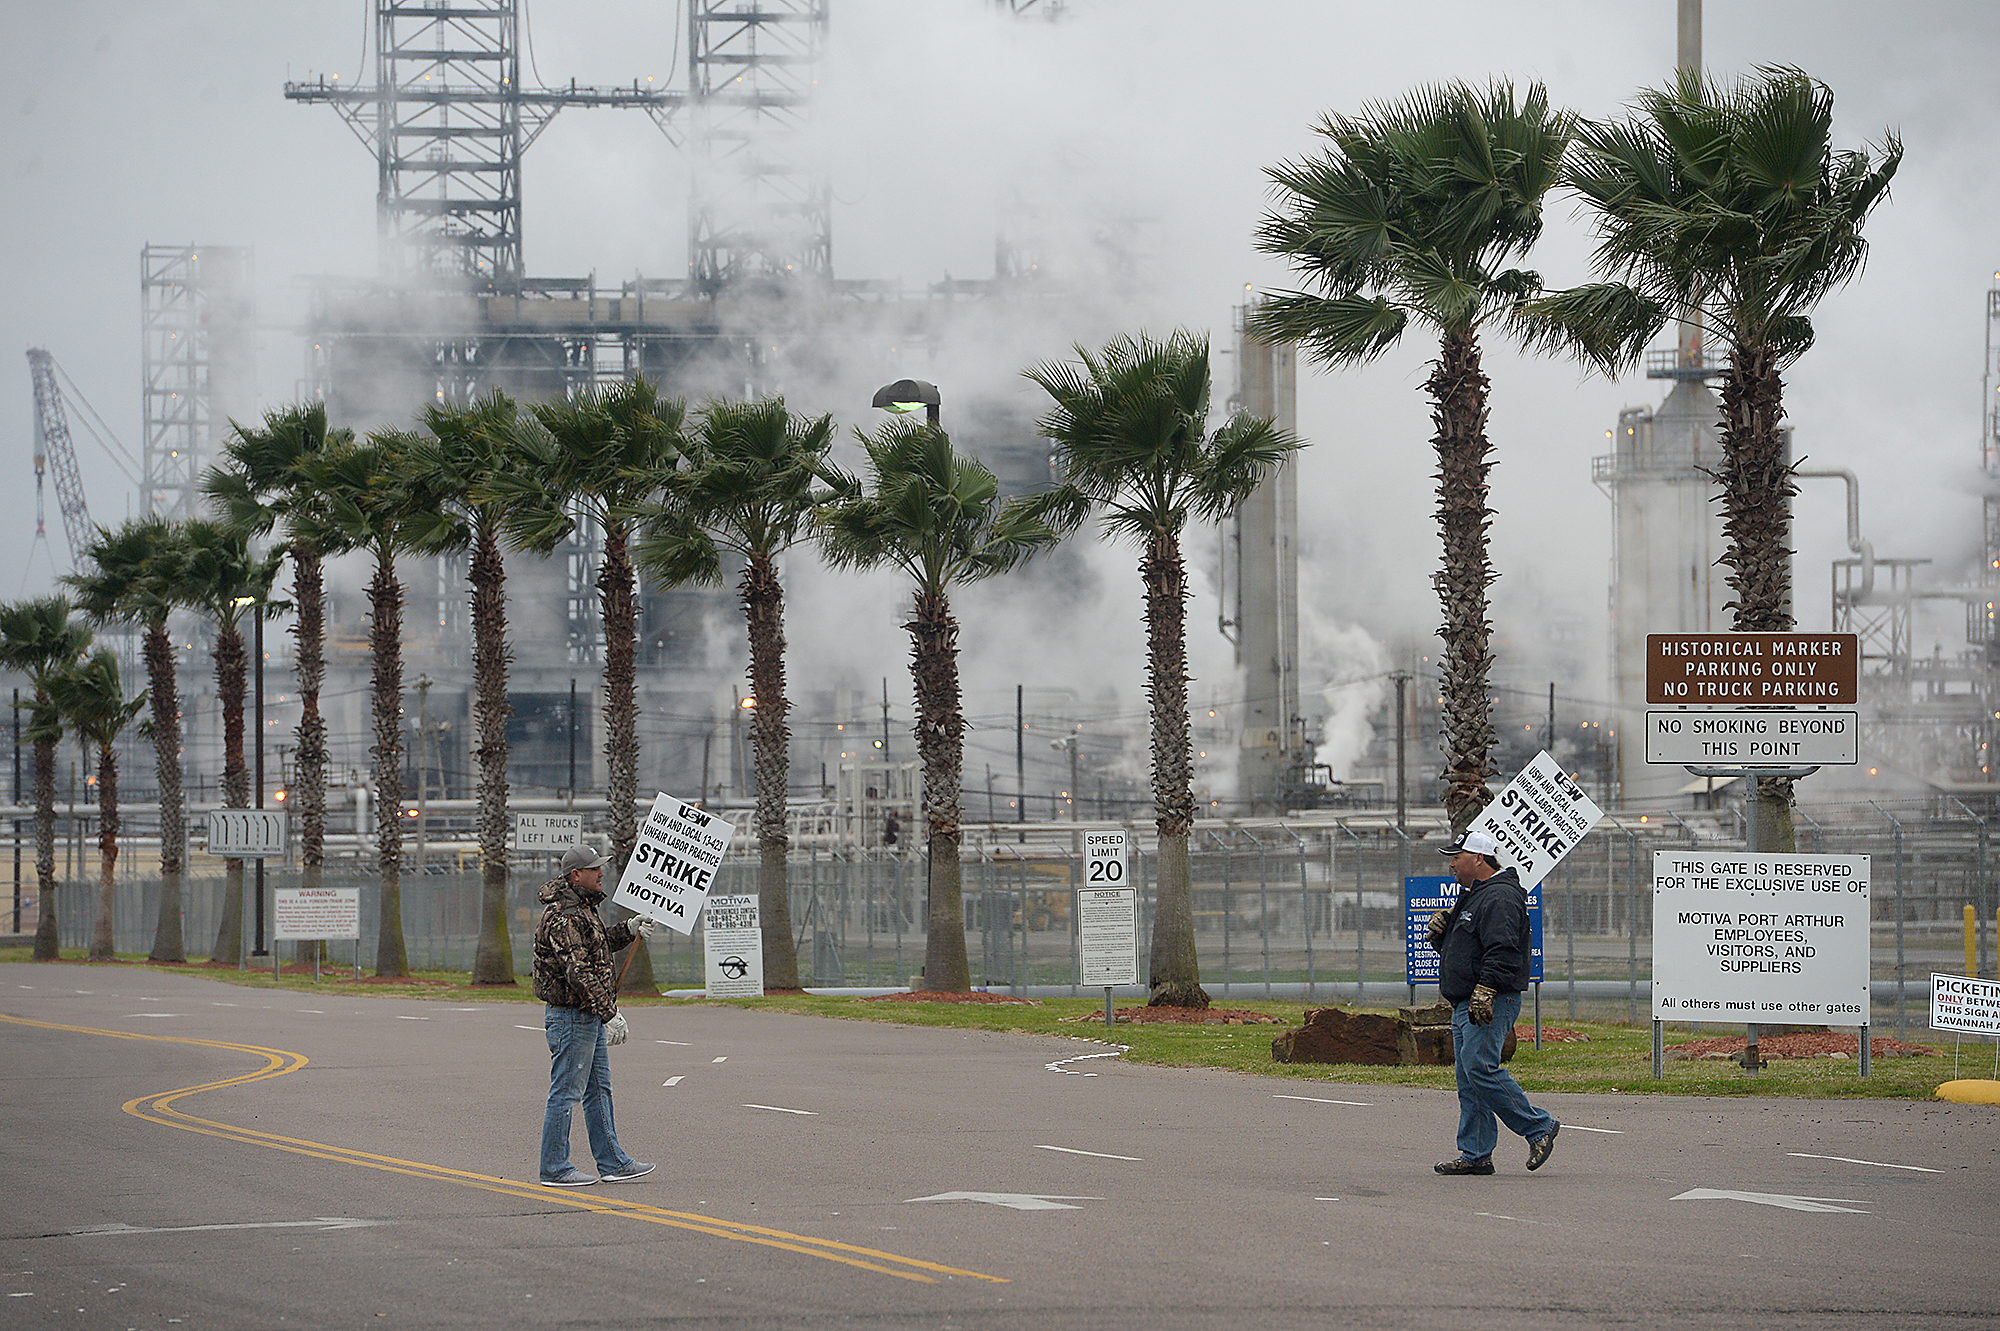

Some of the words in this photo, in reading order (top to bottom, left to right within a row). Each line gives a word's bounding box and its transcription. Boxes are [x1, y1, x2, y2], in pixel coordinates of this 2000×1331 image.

[1662, 642, 1763, 656] HISTORICAL
[1773, 642, 1842, 656] MARKER
[1686, 662, 1762, 676] PARKING
[1772, 662, 1817, 676] ONLY
[1664, 683, 1688, 696] NO
[1698, 683, 1752, 696] TRUCK
[1762, 683, 1839, 696] PARKING
[1659, 720, 1682, 733] NO
[1693, 720, 1767, 733] SMOKING
[1779, 720, 1845, 733] BEYOND
[1702, 742, 1737, 755] THIS
[1750, 742, 1801, 755] POINT
[1554, 771, 1583, 802] USW
[1528, 766, 1544, 783] USW
[1539, 778, 1554, 794] AND
[1550, 791, 1571, 813] LOCAL
[1568, 809, 1588, 830] 13-423
[1516, 774, 1538, 798] UNFAIR
[1534, 793, 1555, 817] LABOR
[1551, 812, 1580, 843] PRACTICE
[520, 818, 536, 827] ALL
[545, 819, 578, 828] TRUCKS
[677, 805, 711, 828] USW
[652, 811, 667, 826] USW
[667, 819, 682, 833] AND
[681, 826, 702, 842] LOCAL
[703, 835, 724, 851] 13-423
[1501, 789, 1567, 860] STRIKE
[523, 834, 544, 842] LEFT
[552, 835, 574, 843] LANE
[1088, 836, 1123, 844] SPEED
[1504, 819, 1538, 853] AGAINST
[644, 824, 667, 844] UNFAIR
[667, 834, 689, 853] LABOR
[688, 845, 720, 867] PRACTICE
[1092, 848, 1119, 857] LIMIT
[1484, 818, 1535, 872] MOTIVA
[636, 842, 711, 892] STRIKE
[1090, 860, 1123, 882] 20
[1672, 861, 1704, 874] THIS
[1711, 862, 1747, 875] GATE
[1754, 863, 1768, 875] IS
[1774, 864, 1851, 877] RESERVED
[645, 873, 685, 895] AGAINST
[1657, 877, 1685, 889] FOR
[1692, 878, 1719, 889] THE
[1726, 879, 1804, 891] EXCLUSIVE
[1811, 881, 1840, 892] USE
[1847, 881, 1867, 893] OF
[626, 882, 685, 917] MOTIVA
[1678, 913, 1731, 925] MOTIVA
[1738, 914, 1778, 925] PORT
[1785, 915, 1844, 927] ARTHUR
[1714, 929, 1808, 944] EMPLOYEES,
[1707, 944, 1778, 959] VISITORS,
[1785, 946, 1816, 957] AND
[1720, 960, 1802, 973] SUPPLIERS
[1662, 998, 1676, 1008] All
[1682, 1000, 1720, 1009] others
[1726, 1000, 1755, 1010] must
[1761, 1003, 1782, 1011] use
[1788, 1002, 1821, 1012] other
[1826, 1003, 1861, 1014] gates
[1938, 994, 1963, 1003] ONLY
[1939, 1005, 1962, 1014] THIS
[1965, 1008, 1988, 1017] SIGN
[1937, 1016, 1992, 1029] SAVANNAH
